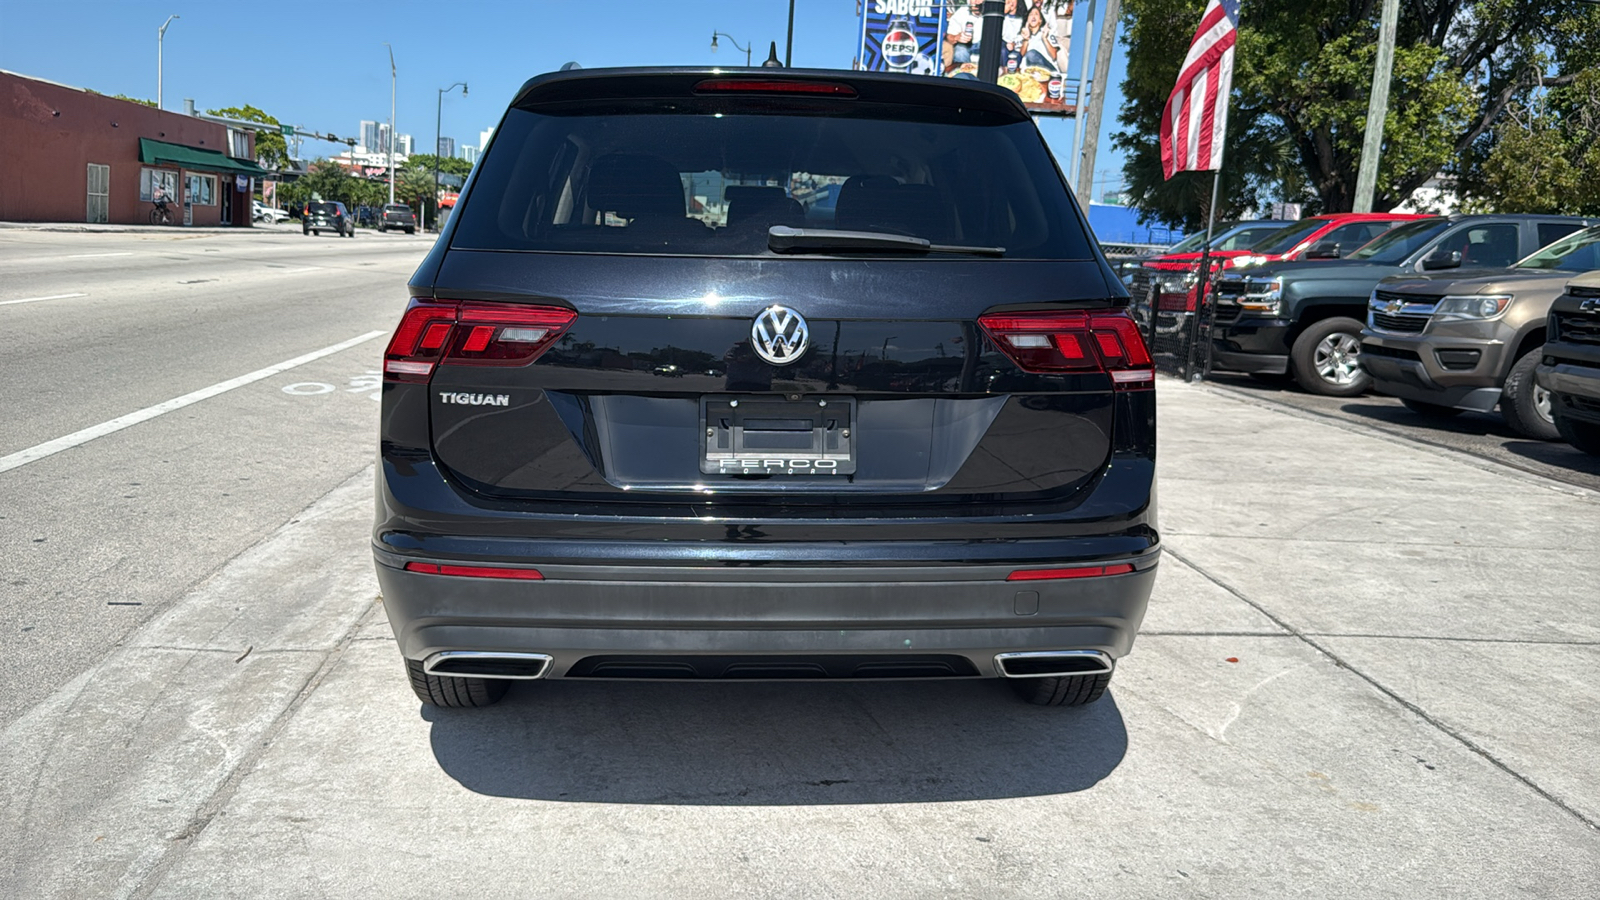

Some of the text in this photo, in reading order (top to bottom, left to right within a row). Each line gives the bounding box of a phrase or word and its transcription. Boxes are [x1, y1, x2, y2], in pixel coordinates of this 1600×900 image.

[875, 0, 932, 17] SABOR
[885, 43, 915, 53] PEPSI
[752, 306, 808, 362] VW
[439, 392, 509, 406] TIGUAN
[719, 459, 837, 468] FERCO
